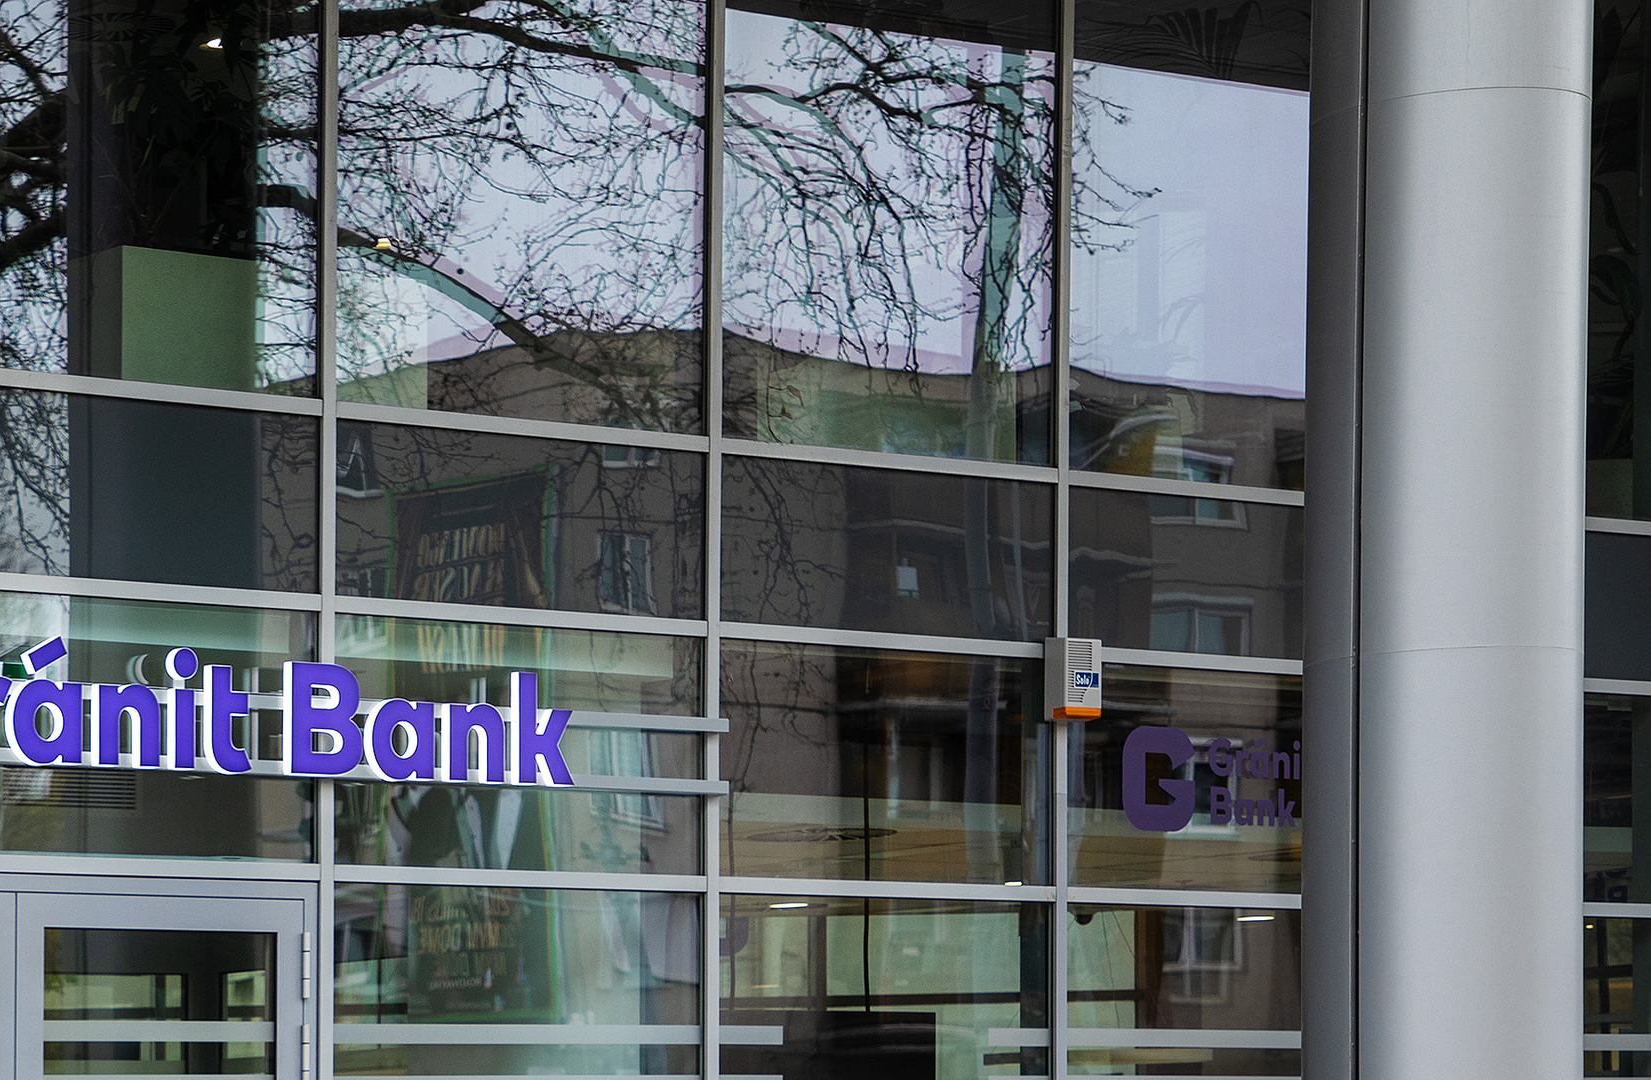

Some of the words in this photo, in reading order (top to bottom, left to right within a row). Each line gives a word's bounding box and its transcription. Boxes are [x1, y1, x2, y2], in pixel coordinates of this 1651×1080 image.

[283, 658, 575, 786] Bank
[1208, 737, 1301, 780] Gráni
[1122, 725, 1196, 832] G
[1210, 786, 1296, 827] Bank
